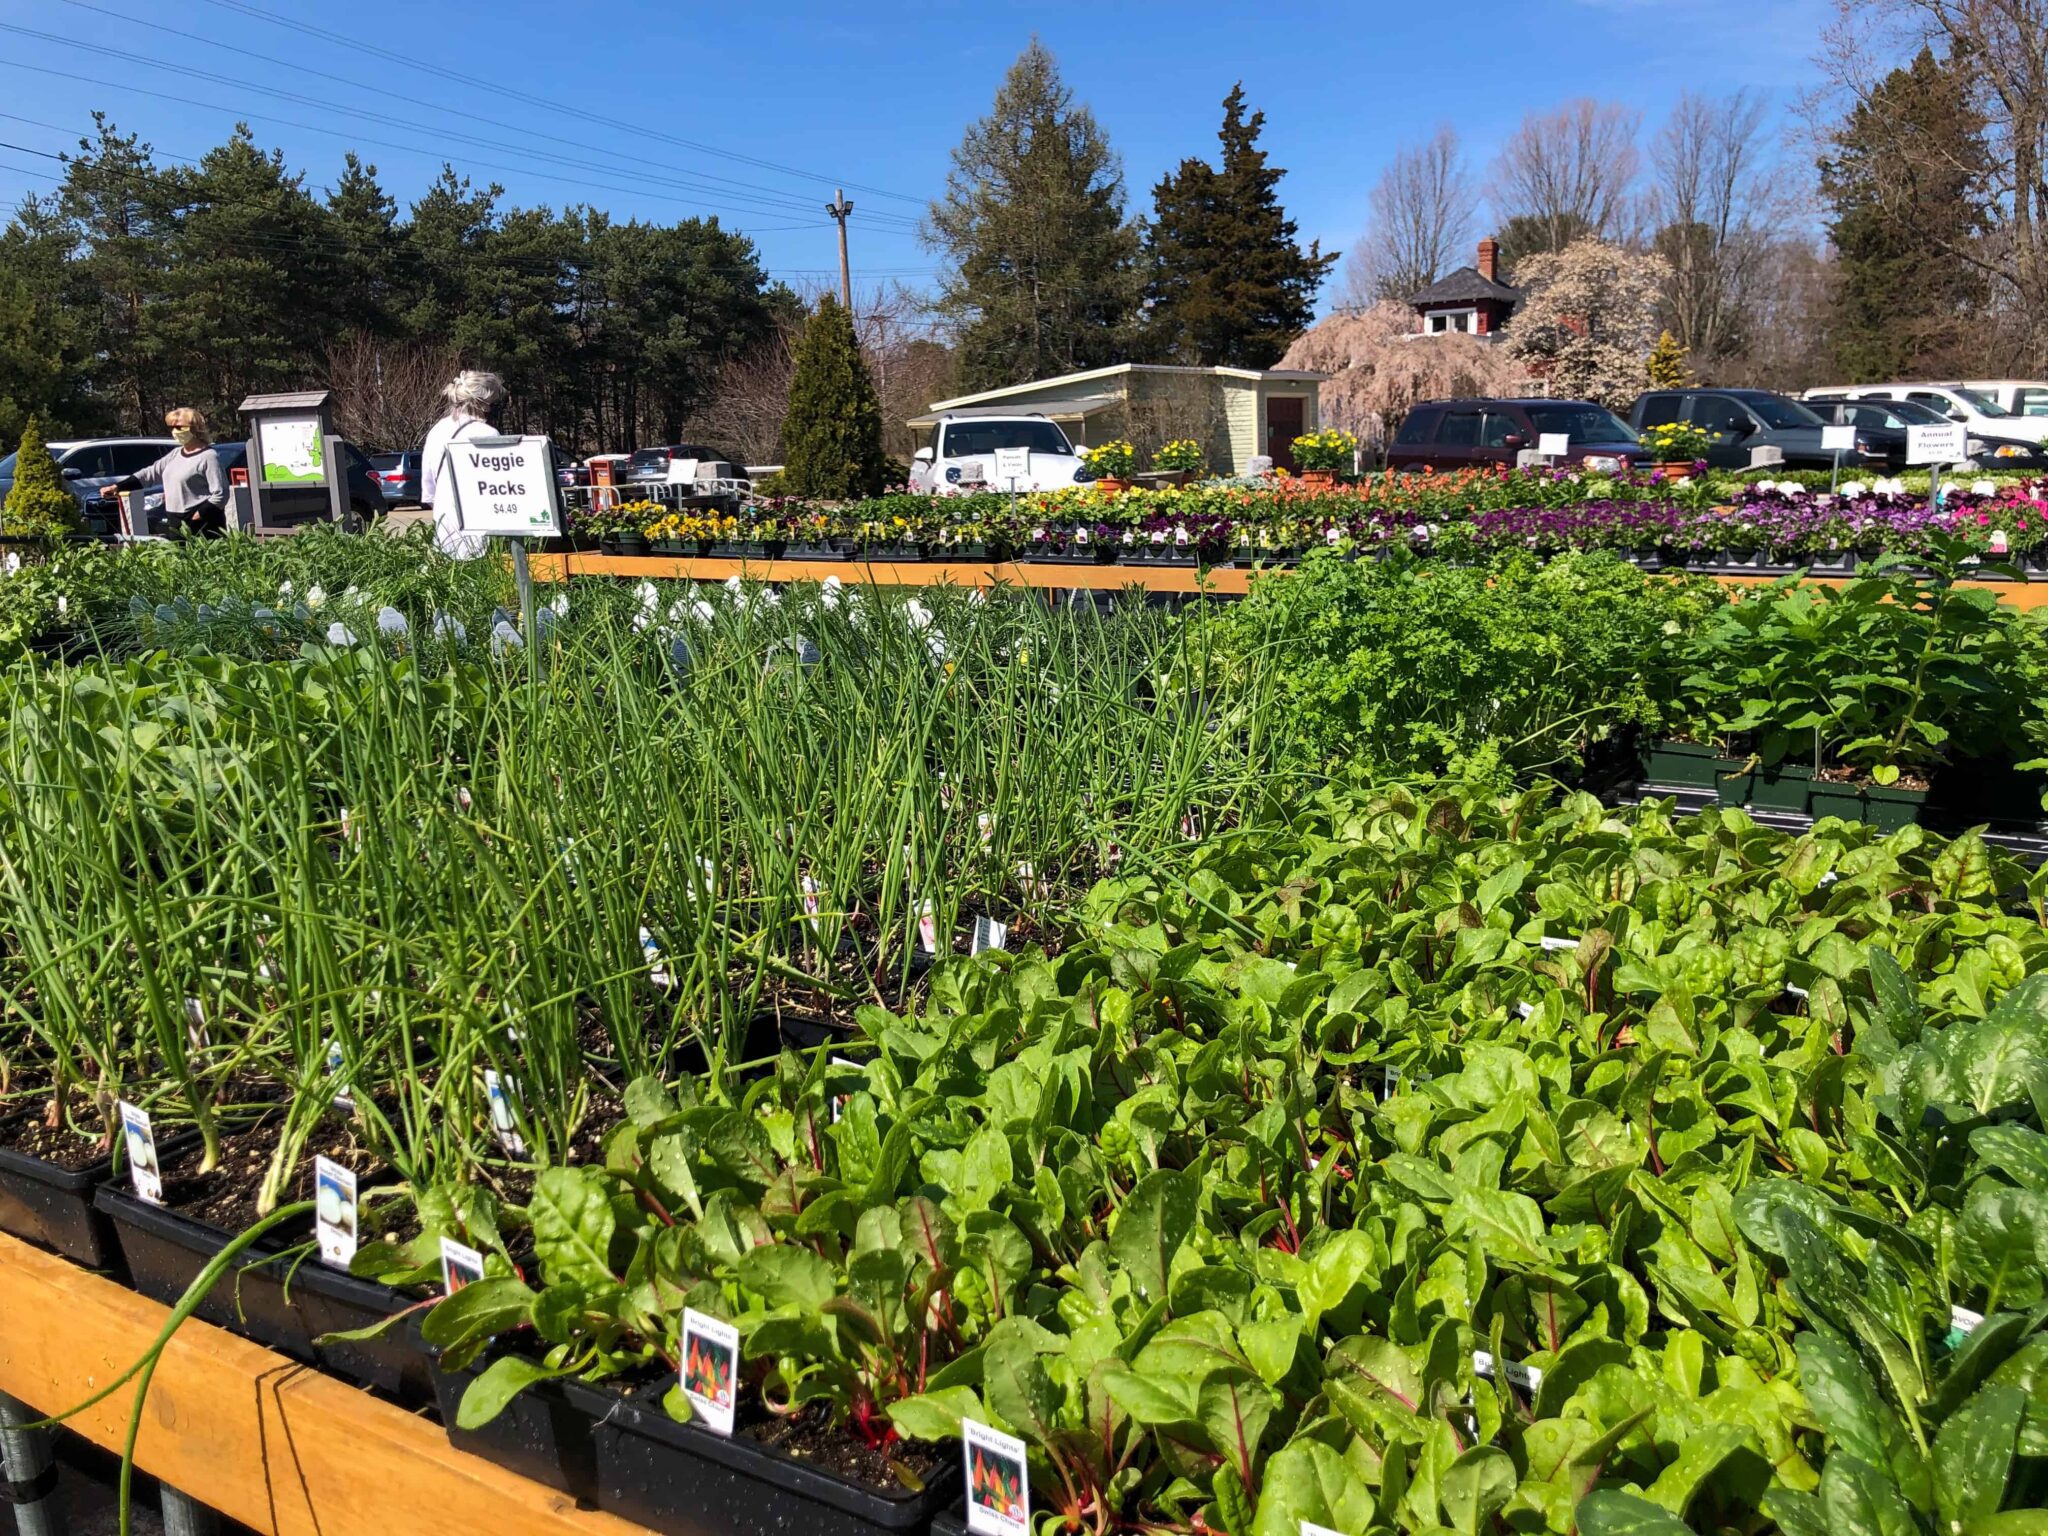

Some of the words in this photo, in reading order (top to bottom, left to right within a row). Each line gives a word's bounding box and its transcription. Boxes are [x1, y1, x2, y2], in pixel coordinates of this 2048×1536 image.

[469, 452, 525, 471] Veggie
[477, 480, 526, 496] Packs
[493, 503, 518, 514] $4.49
